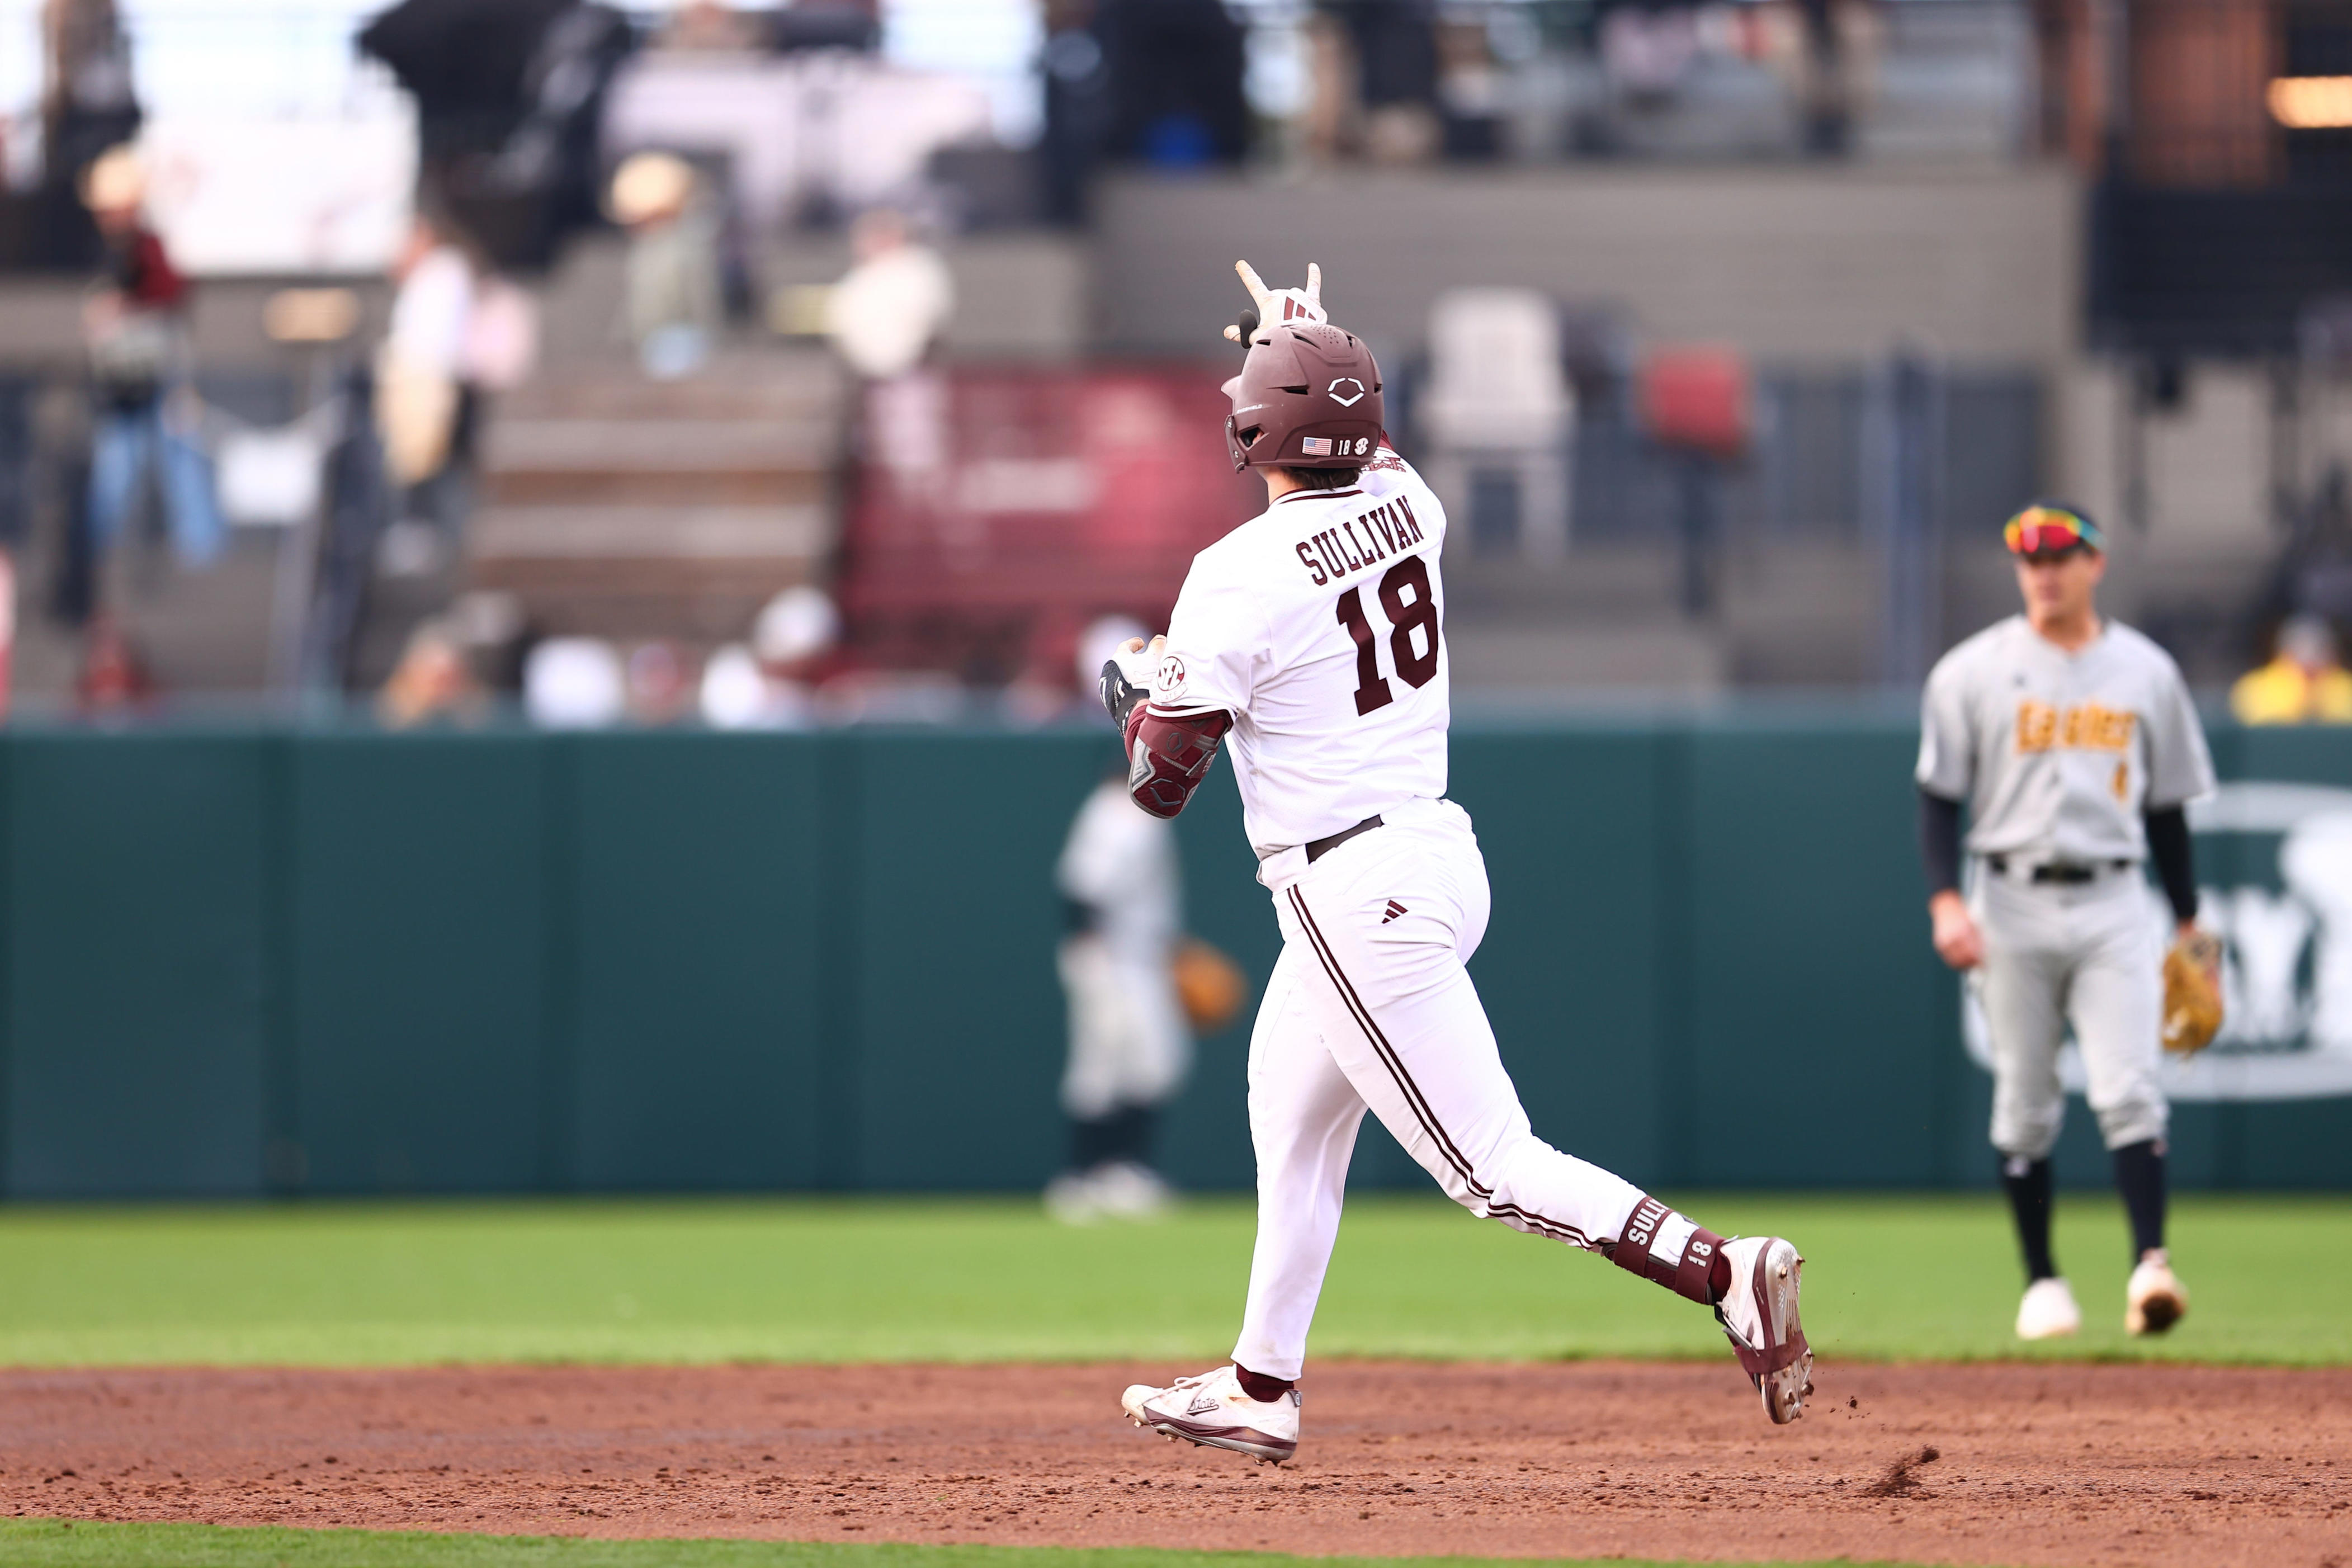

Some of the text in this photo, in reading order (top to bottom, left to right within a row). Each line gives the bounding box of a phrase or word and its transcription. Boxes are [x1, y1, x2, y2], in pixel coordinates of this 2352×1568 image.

[1338, 440, 1350, 456] 18
[1296, 495, 1424, 586] SULLIVAN
[1336, 555, 1438, 716] 18
[1688, 1240, 1712, 1267] 18
[1187, 1397, 1219, 1415] State
